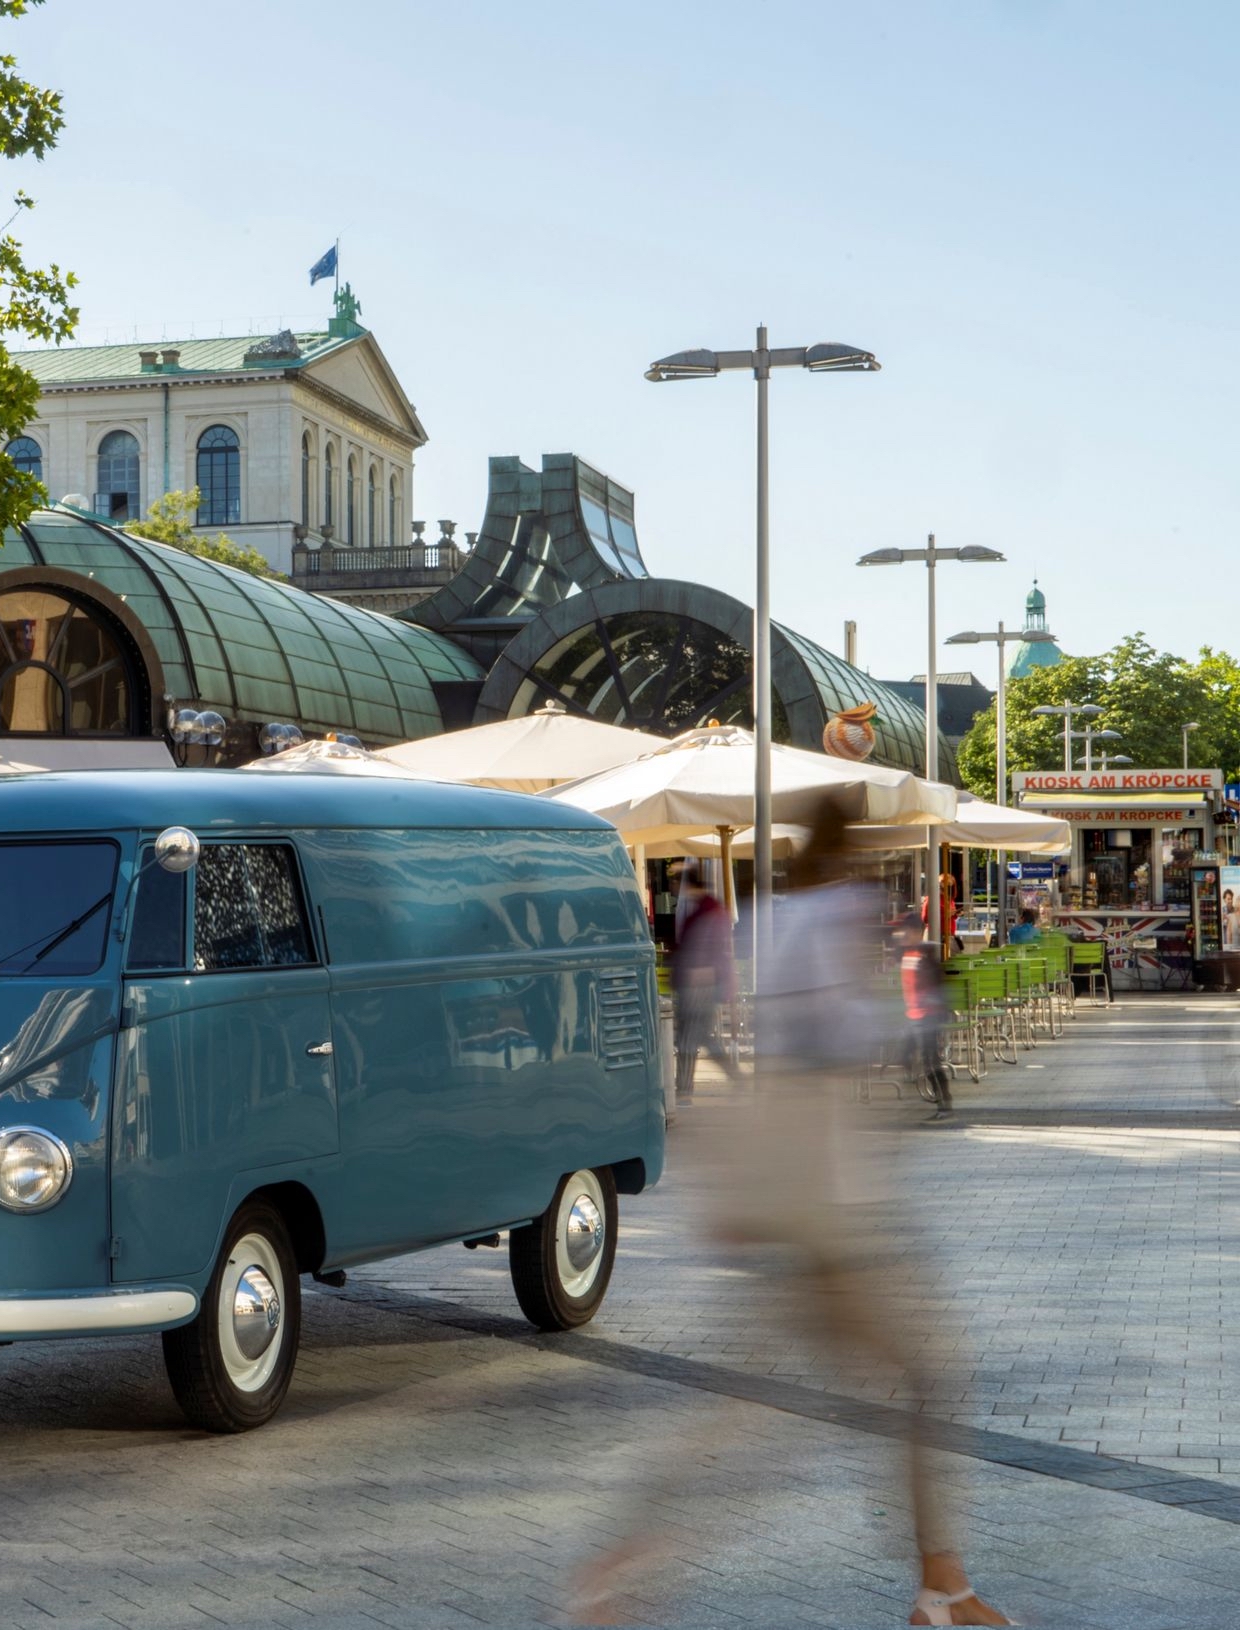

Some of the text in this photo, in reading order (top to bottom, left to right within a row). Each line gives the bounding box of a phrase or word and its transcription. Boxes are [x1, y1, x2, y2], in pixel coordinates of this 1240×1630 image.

[1024, 772, 1213, 790] KIOSK AM KRÖPCKE
[1096, 810, 1115, 821] AM
